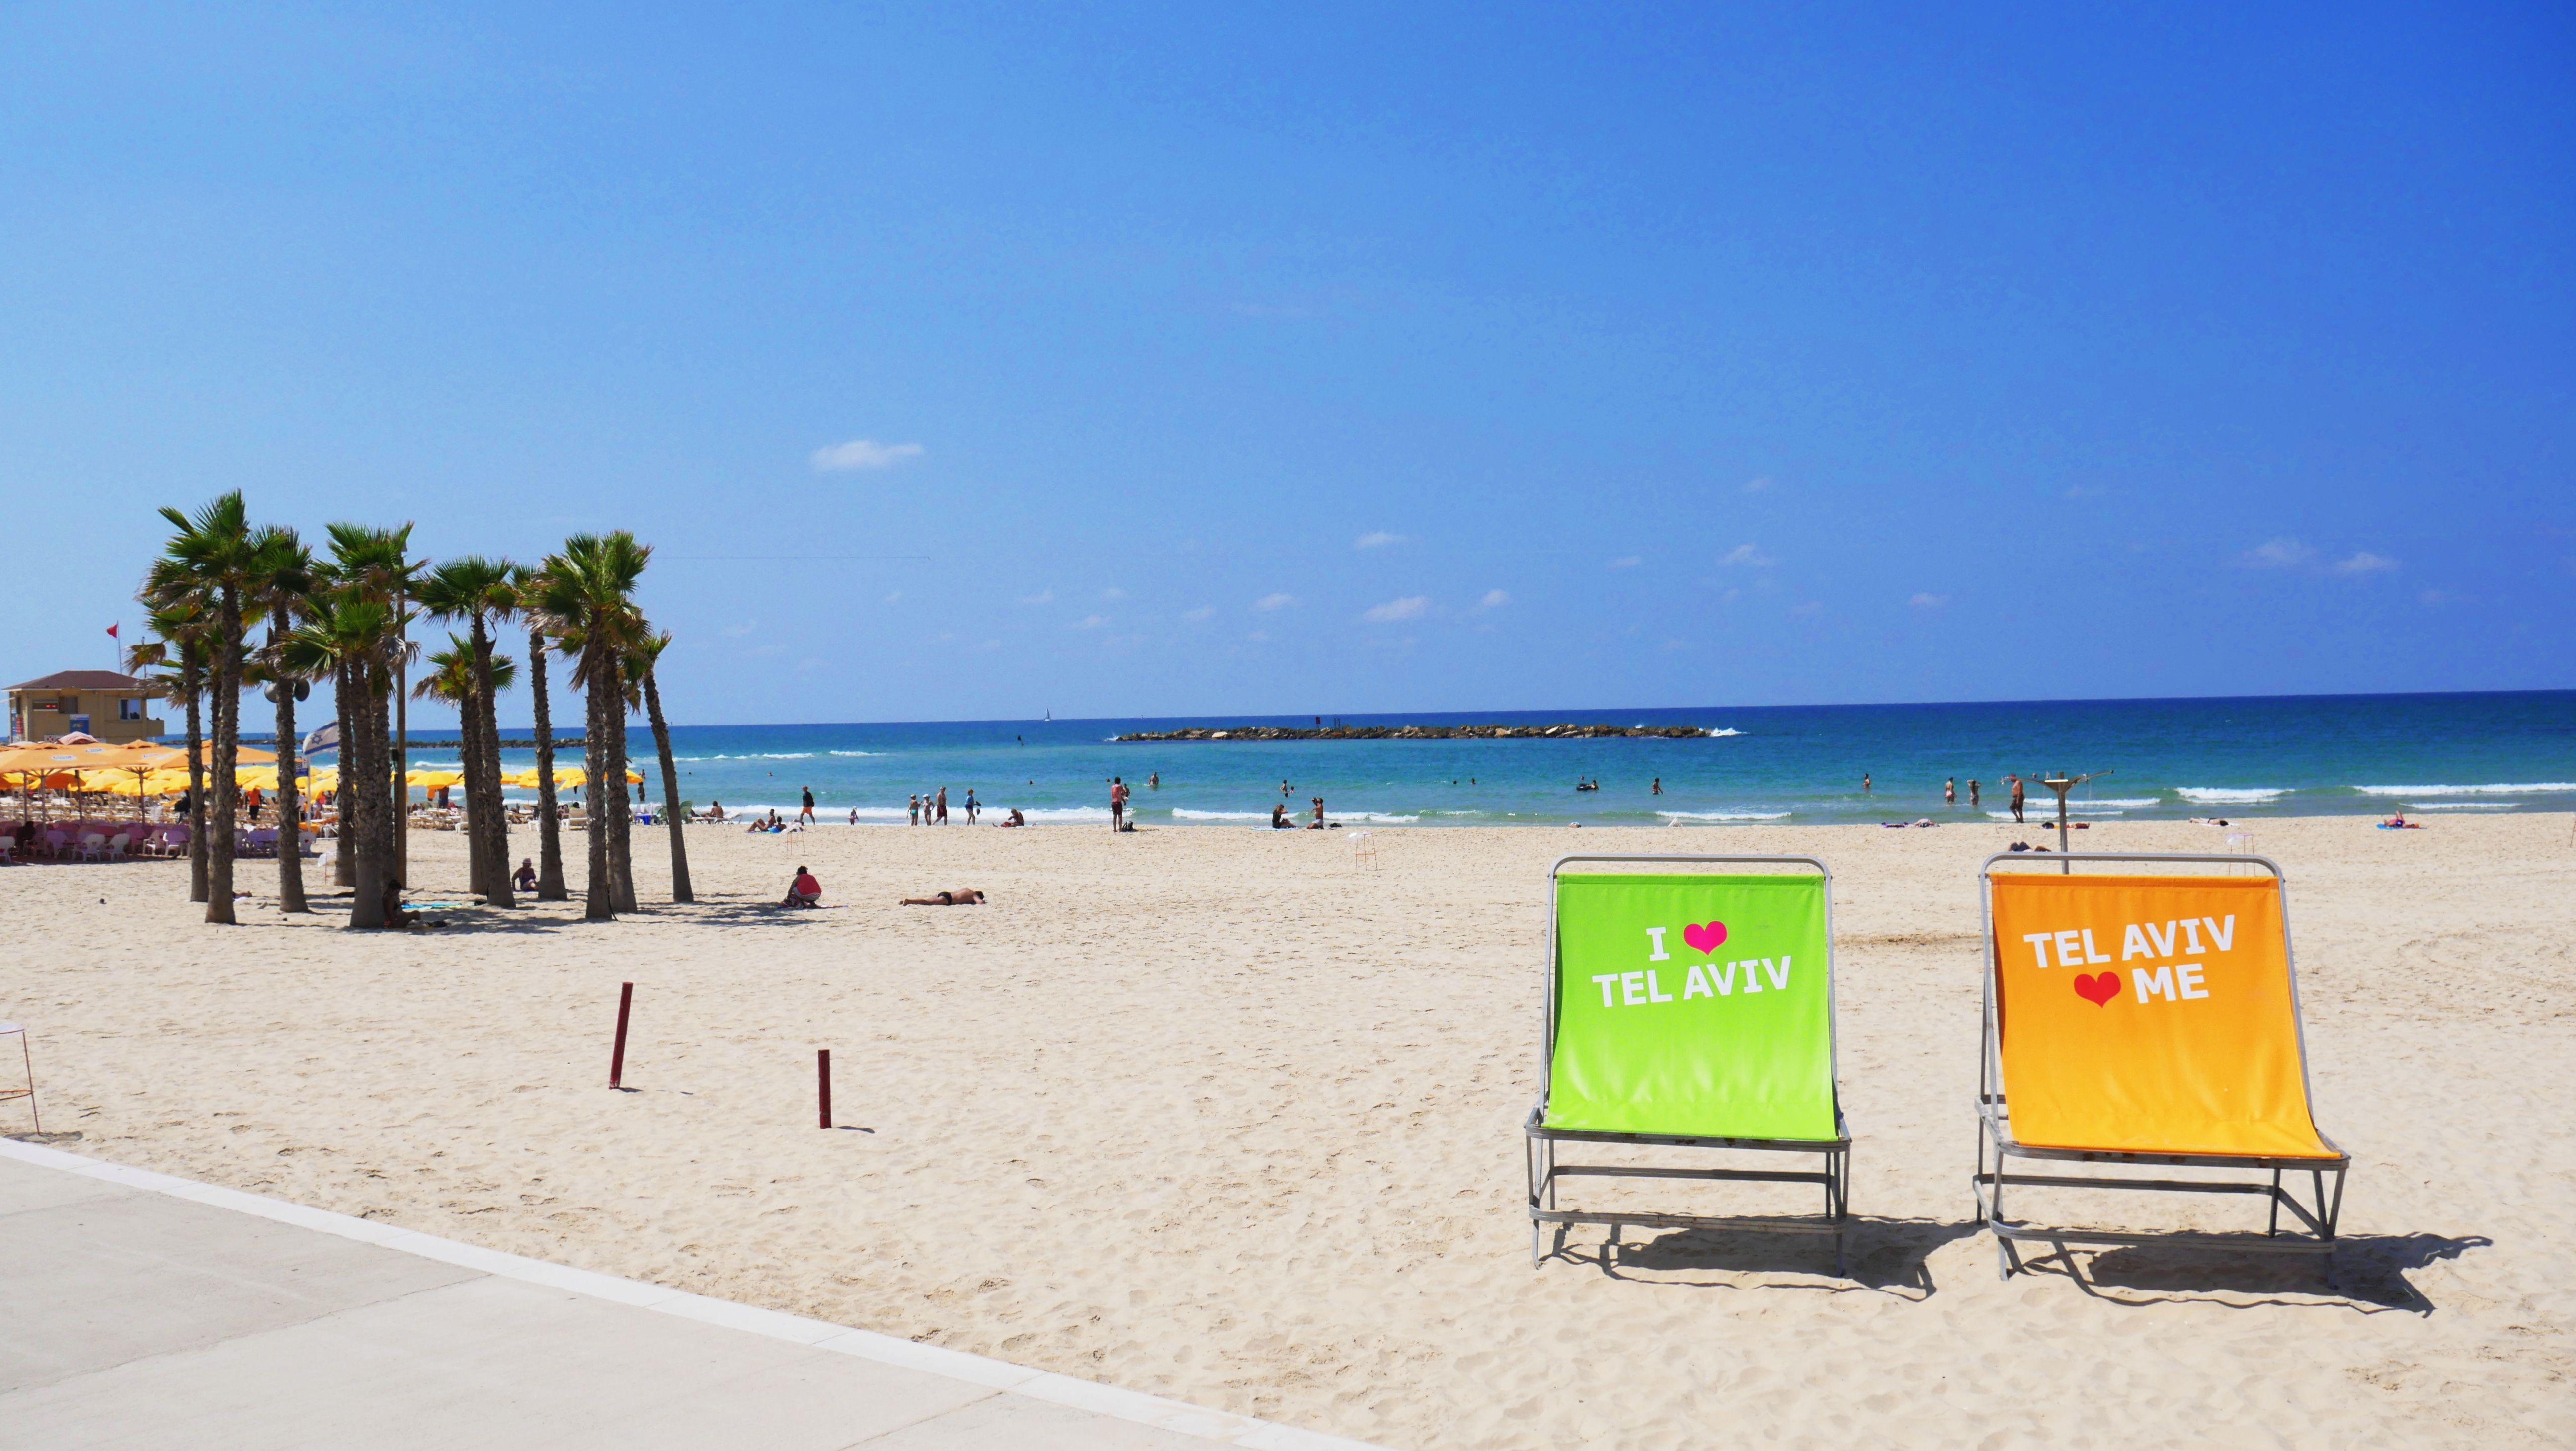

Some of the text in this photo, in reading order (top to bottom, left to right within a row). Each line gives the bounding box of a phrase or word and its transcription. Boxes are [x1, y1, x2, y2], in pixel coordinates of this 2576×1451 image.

[1646, 926, 1670, 961] I
[2023, 915, 2235, 967] TEL AVIV
[1592, 955, 1792, 1007] TEL AVIV
[2132, 963, 2209, 1004] ME
